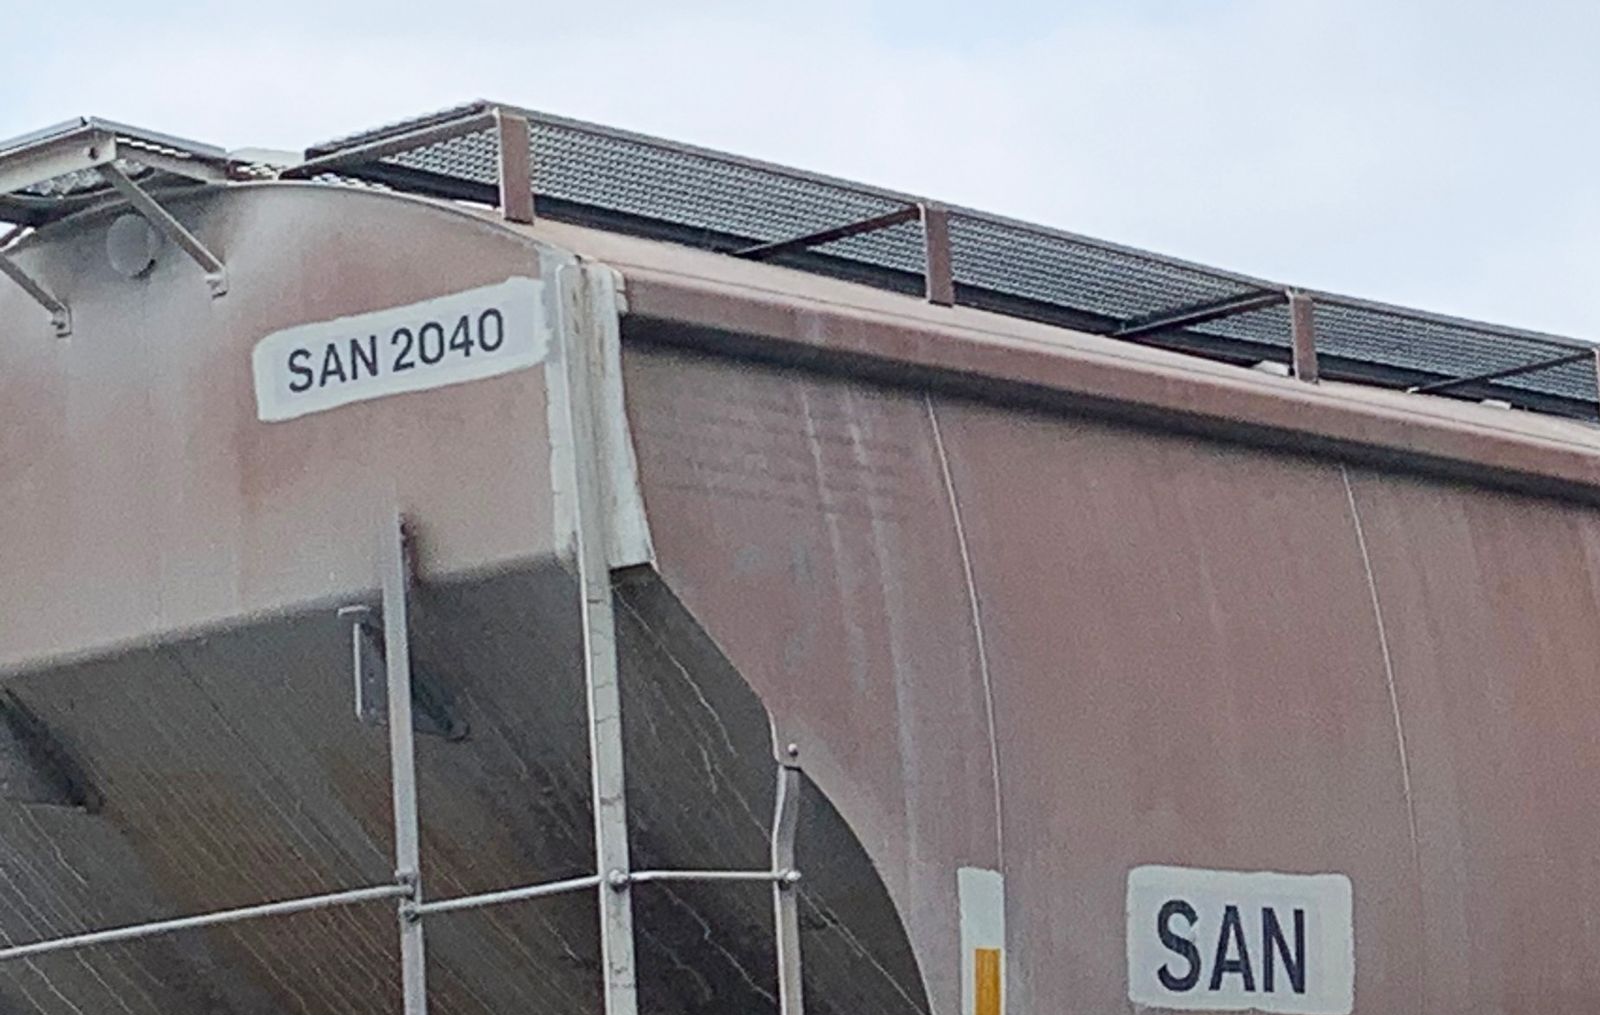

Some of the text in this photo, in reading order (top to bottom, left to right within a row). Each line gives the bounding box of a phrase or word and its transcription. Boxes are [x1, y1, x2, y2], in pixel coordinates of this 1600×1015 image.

[287, 307, 505, 393] SAN 2040
[1156, 899, 1307, 995] SAN
